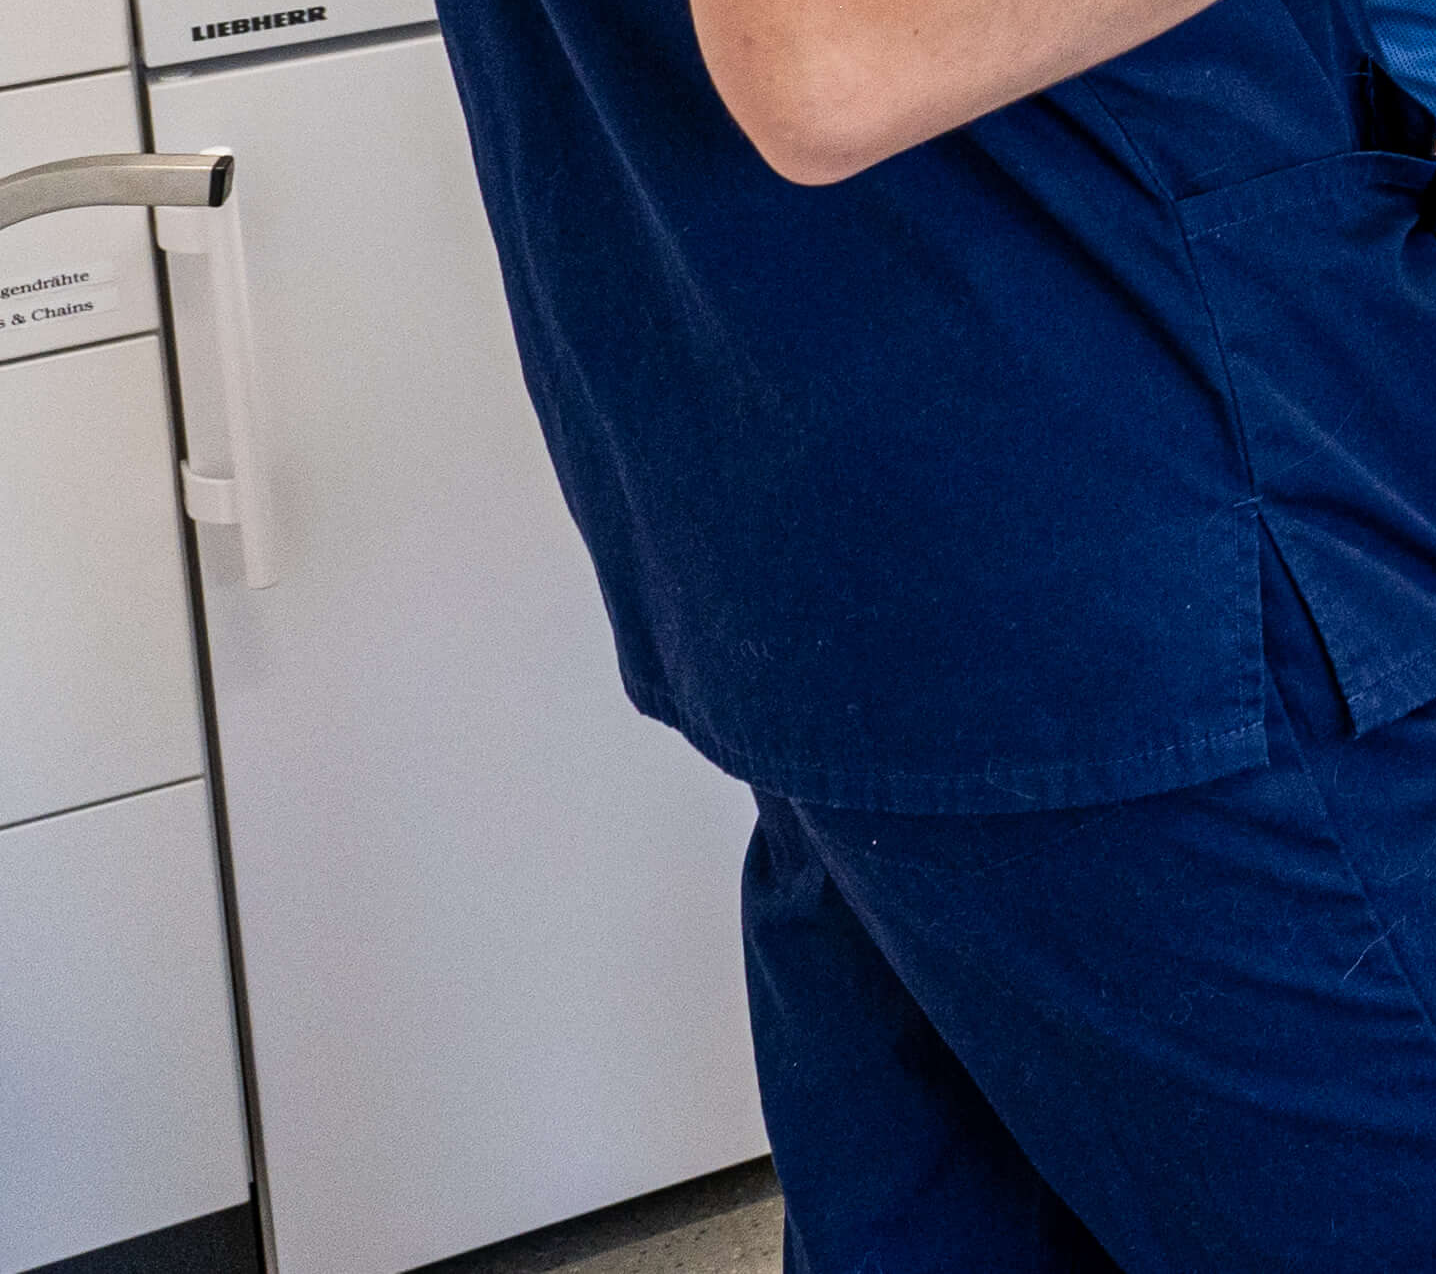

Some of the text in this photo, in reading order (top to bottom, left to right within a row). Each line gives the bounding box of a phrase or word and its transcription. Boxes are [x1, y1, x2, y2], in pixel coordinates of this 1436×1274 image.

[192, 6, 327, 42] LIEBHERR
[11, 313, 26, 326] &
[31, 301, 94, 322] Chains
